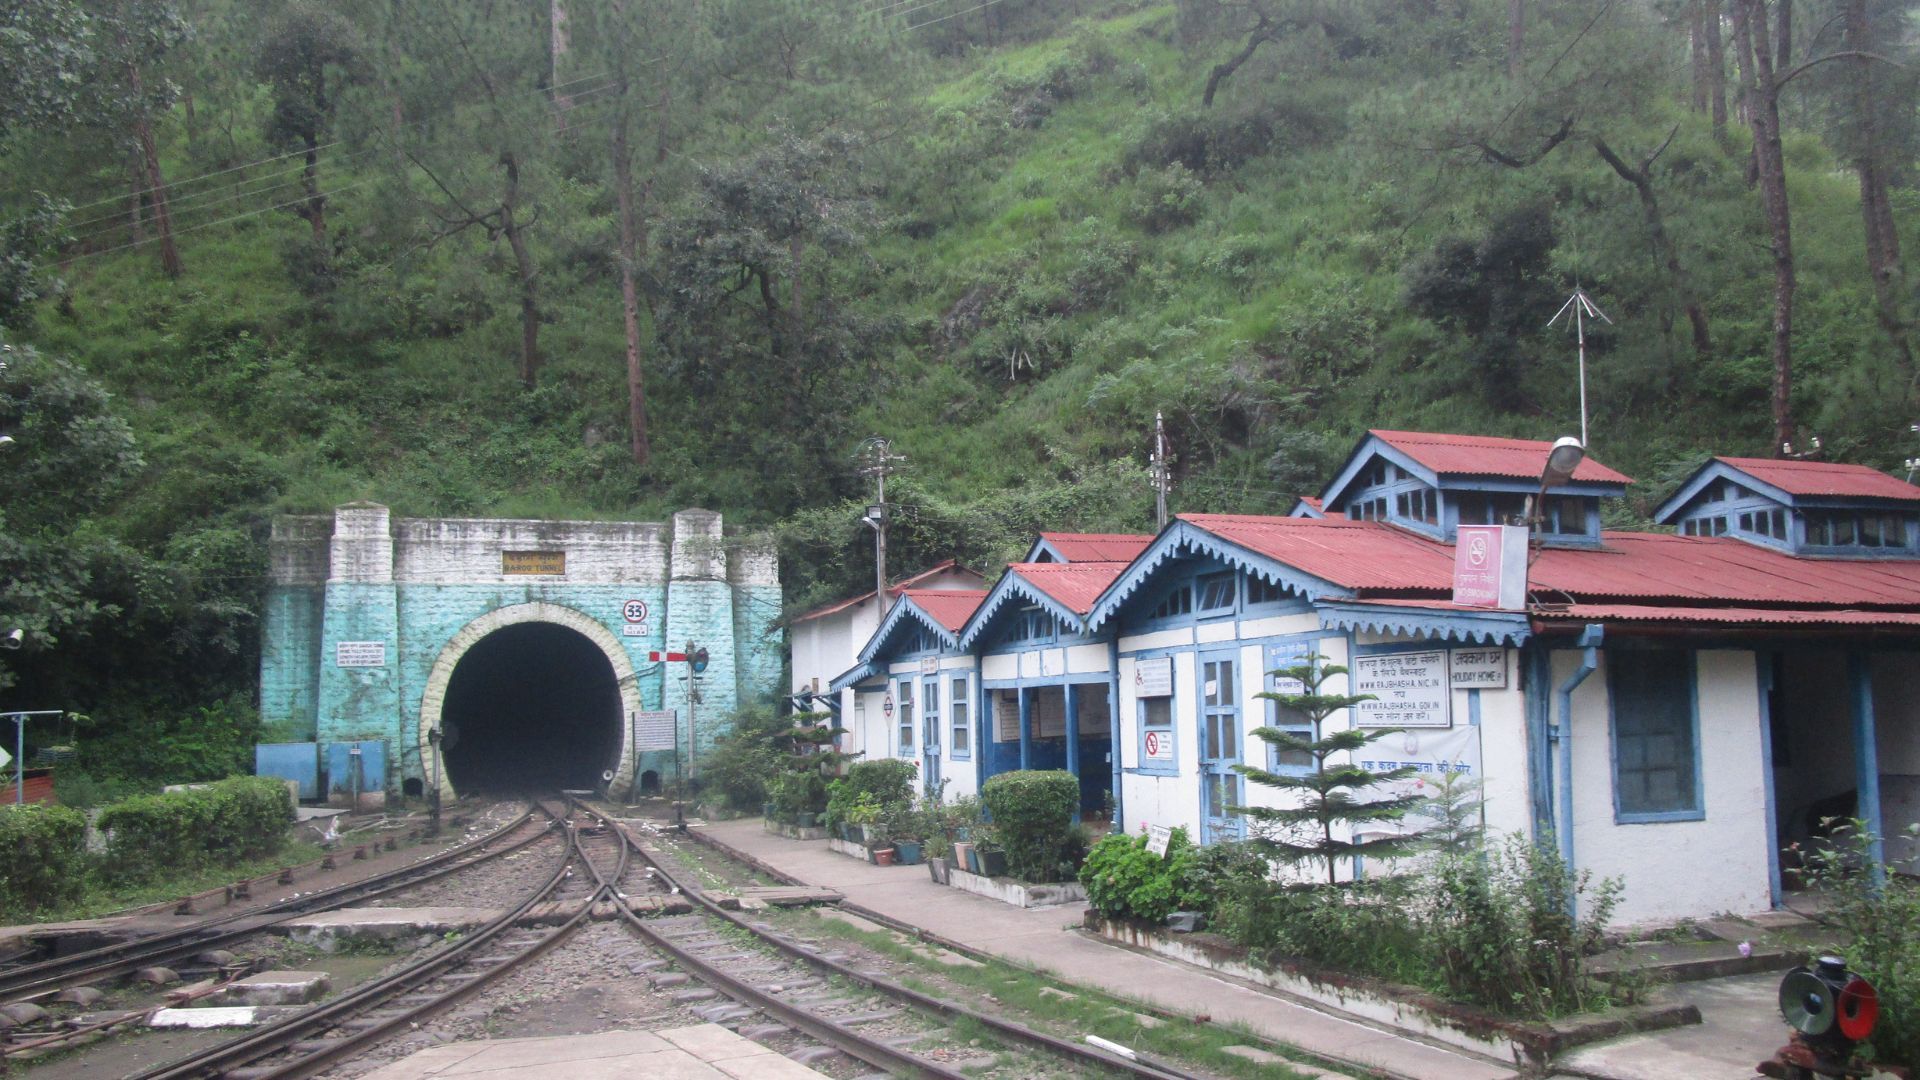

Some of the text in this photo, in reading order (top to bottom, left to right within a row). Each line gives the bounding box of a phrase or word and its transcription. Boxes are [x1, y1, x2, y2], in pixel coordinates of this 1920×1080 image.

[627, 605, 642, 617] 33
[1451, 671, 1476, 682] HOLIDAY
[1478, 670, 1496, 682] HOME
[1361, 760, 1375, 770] एक
[1378, 761, 1398, 771] कदम
